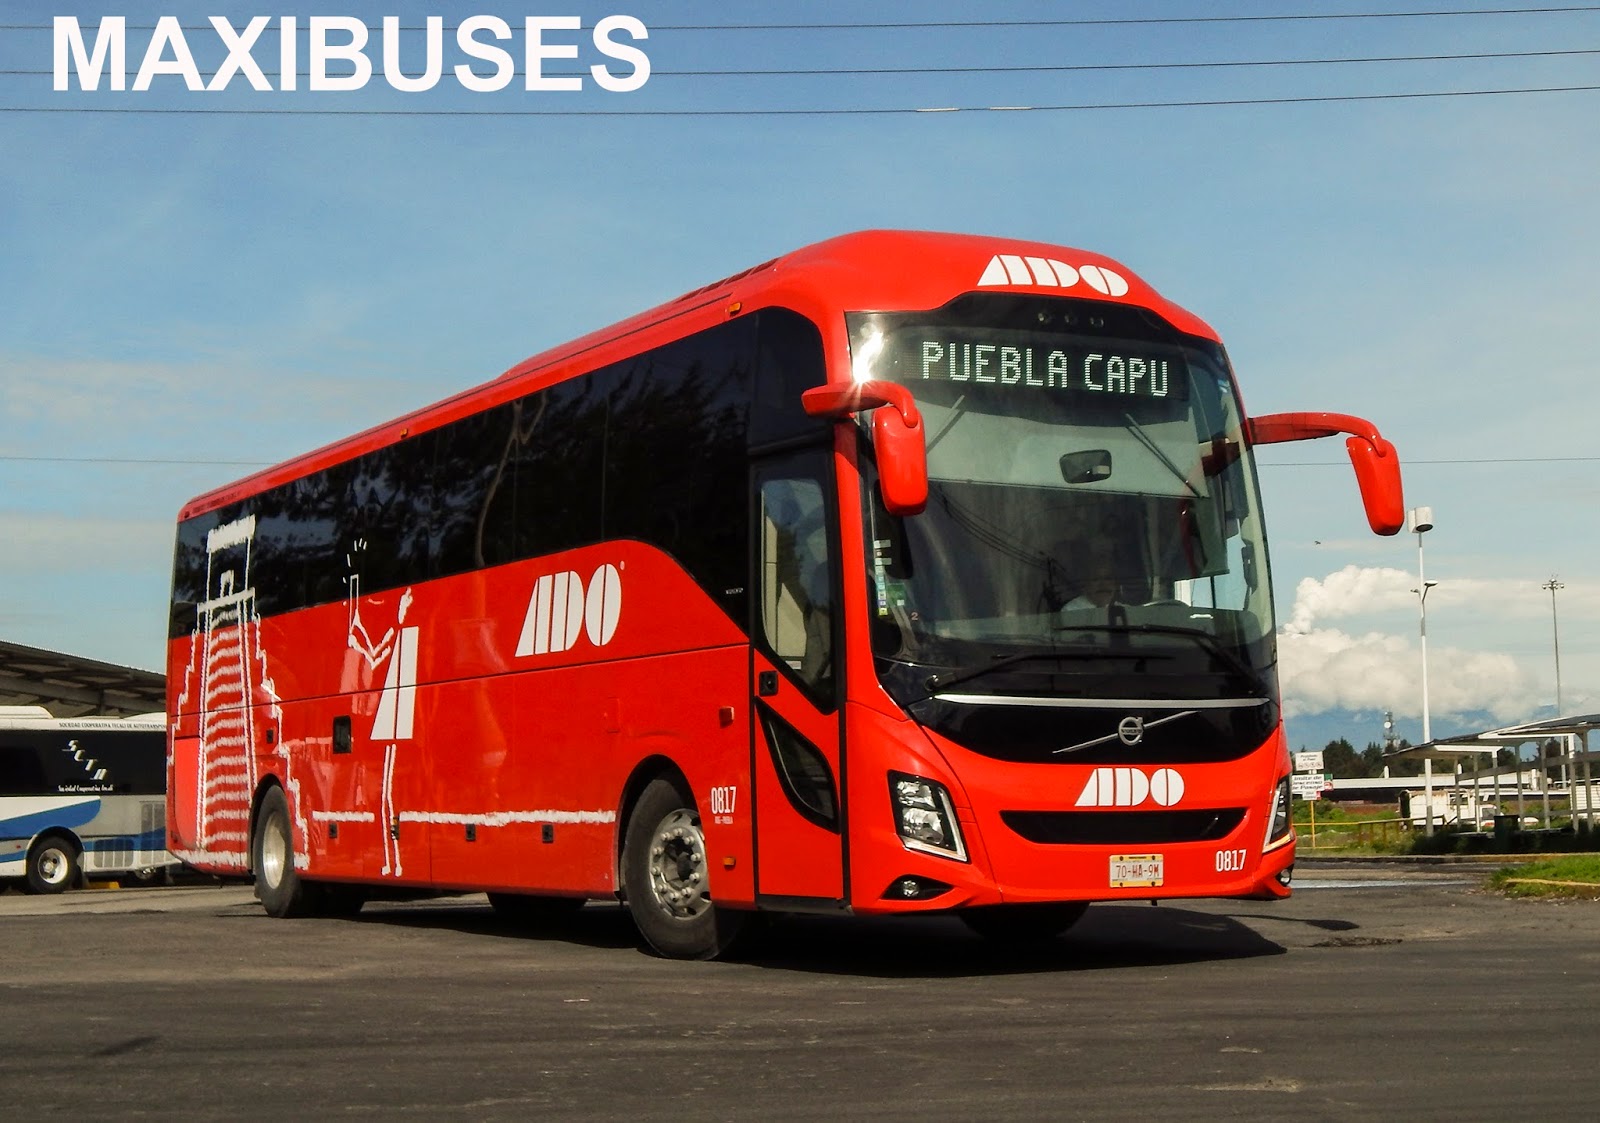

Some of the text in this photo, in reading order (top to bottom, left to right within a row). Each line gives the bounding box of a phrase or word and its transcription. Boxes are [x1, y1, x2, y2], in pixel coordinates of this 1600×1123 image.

[977, 254, 1129, 297] ADO
[922, 341, 1168, 397] PUEBLA CAPU
[514, 563, 622, 658] ADO
[711, 786, 737, 815] 0817
[1074, 768, 1185, 807] ADO
[1215, 849, 1247, 872] 0817
